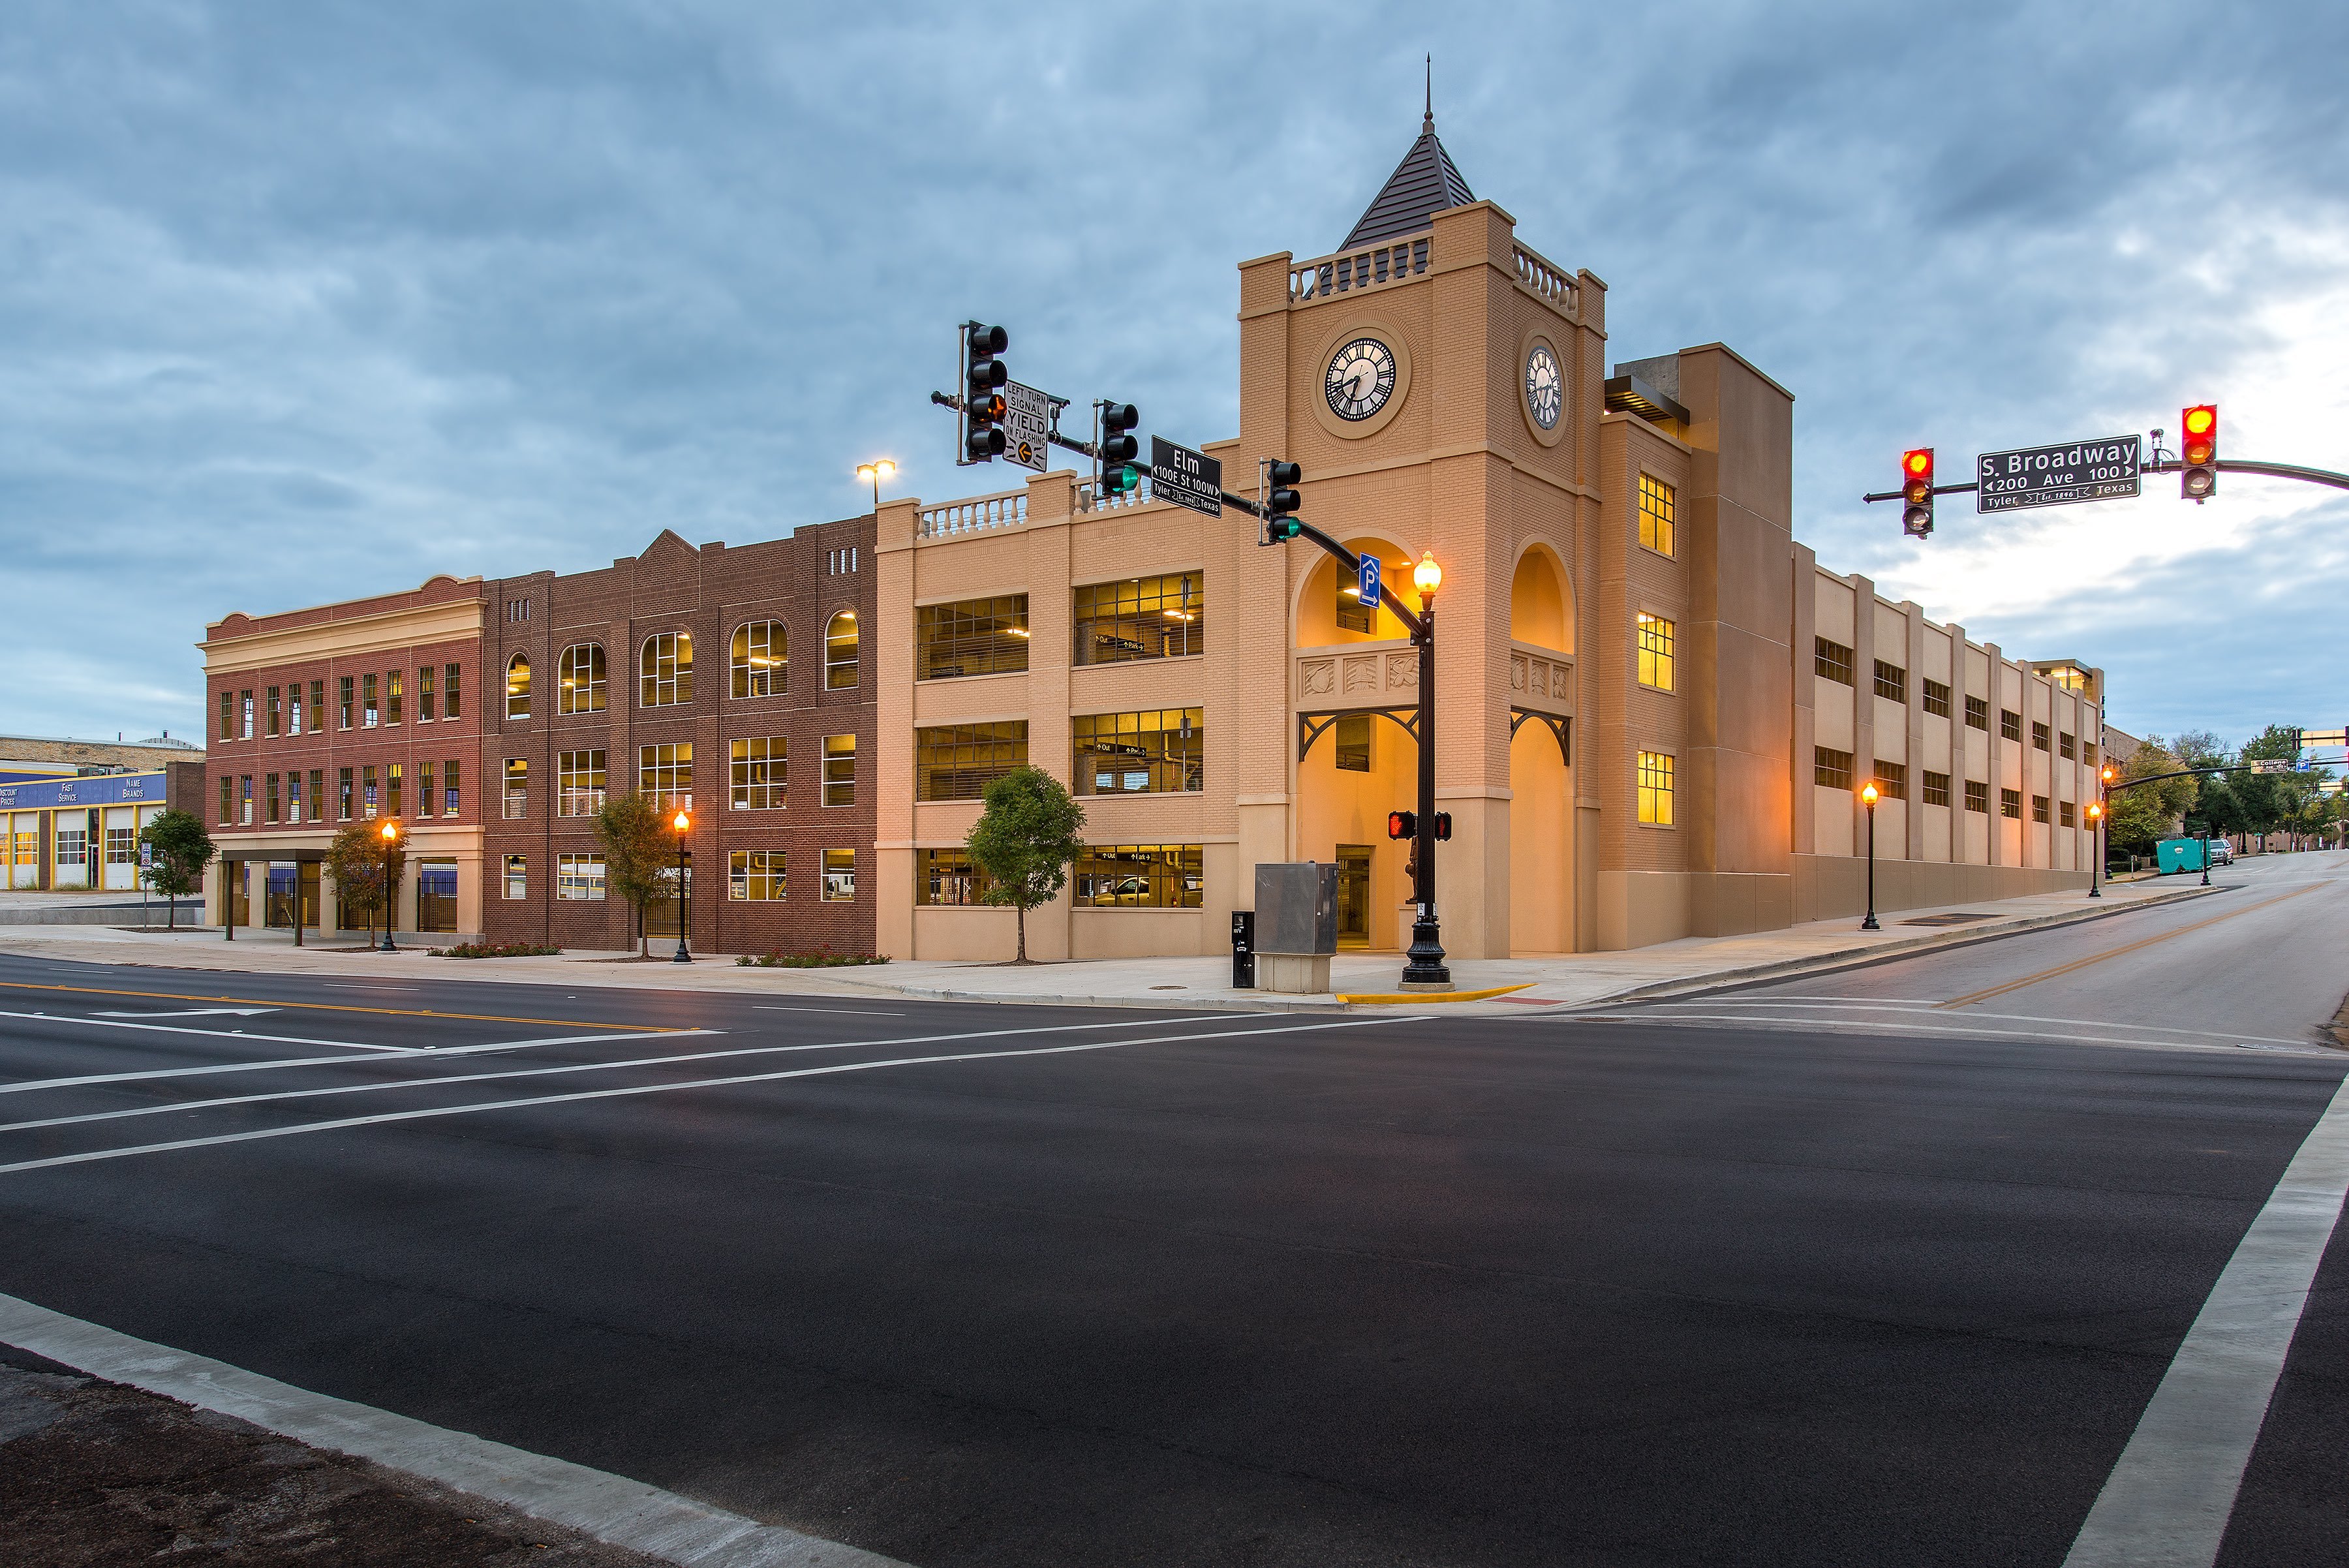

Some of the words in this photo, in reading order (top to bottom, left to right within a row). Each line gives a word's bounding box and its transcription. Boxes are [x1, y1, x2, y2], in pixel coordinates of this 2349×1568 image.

[1007, 384, 1024, 397] LEFT
[1028, 391, 1045, 405] TURN
[1011, 397, 1042, 416] SIGNAL
[1007, 410, 1045, 435] YIELD
[1006, 425, 1013, 436] ON
[1015, 428, 1045, 446] FLASHING
[1174, 450, 1199, 474] Elm
[1982, 458, 2000, 477] S.
[2008, 443, 2136, 474] Broadway
[1159, 466, 1178, 483] 100E
[1181, 474, 1190, 487] St
[1193, 478, 1214, 495] 100W
[1997, 477, 2027, 491] 200
[2043, 472, 2074, 486] Ave
[2089, 466, 2119, 480] 100
[2096, 484, 2132, 494] Texas
[1201, 499, 1219, 512] Texas
[1366, 569, 1375, 591] P
[62, 783, 74, 792] FAST
[126, 778, 141, 788] NAME
[1, 797, 15, 806] PRICES
[58, 793, 78, 802] SERVICE
[123, 789, 144, 798] BRANDS
